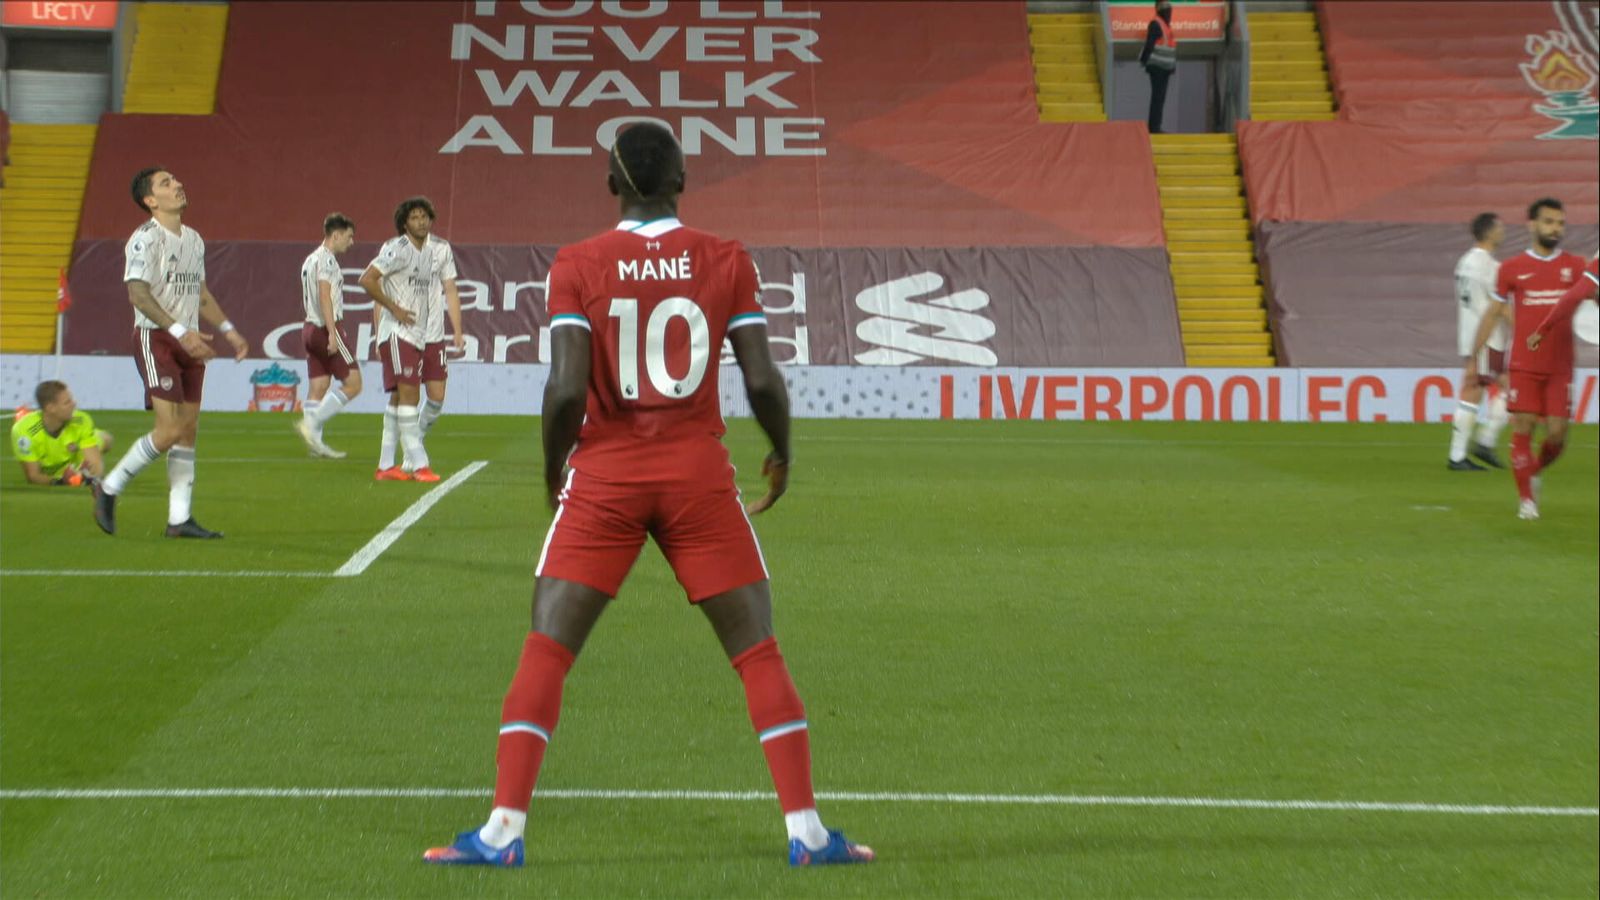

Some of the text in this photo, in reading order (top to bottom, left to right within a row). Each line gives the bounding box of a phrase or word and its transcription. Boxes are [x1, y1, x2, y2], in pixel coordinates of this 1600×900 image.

[451, 24, 822, 62] NEVER
[475, 69, 798, 109] WALK
[617, 250, 692, 281] MANÉ
[608, 296, 710, 400] 10
[940, 374, 1281, 421] LIVERPOOL
[1307, 375, 1388, 422] FC
